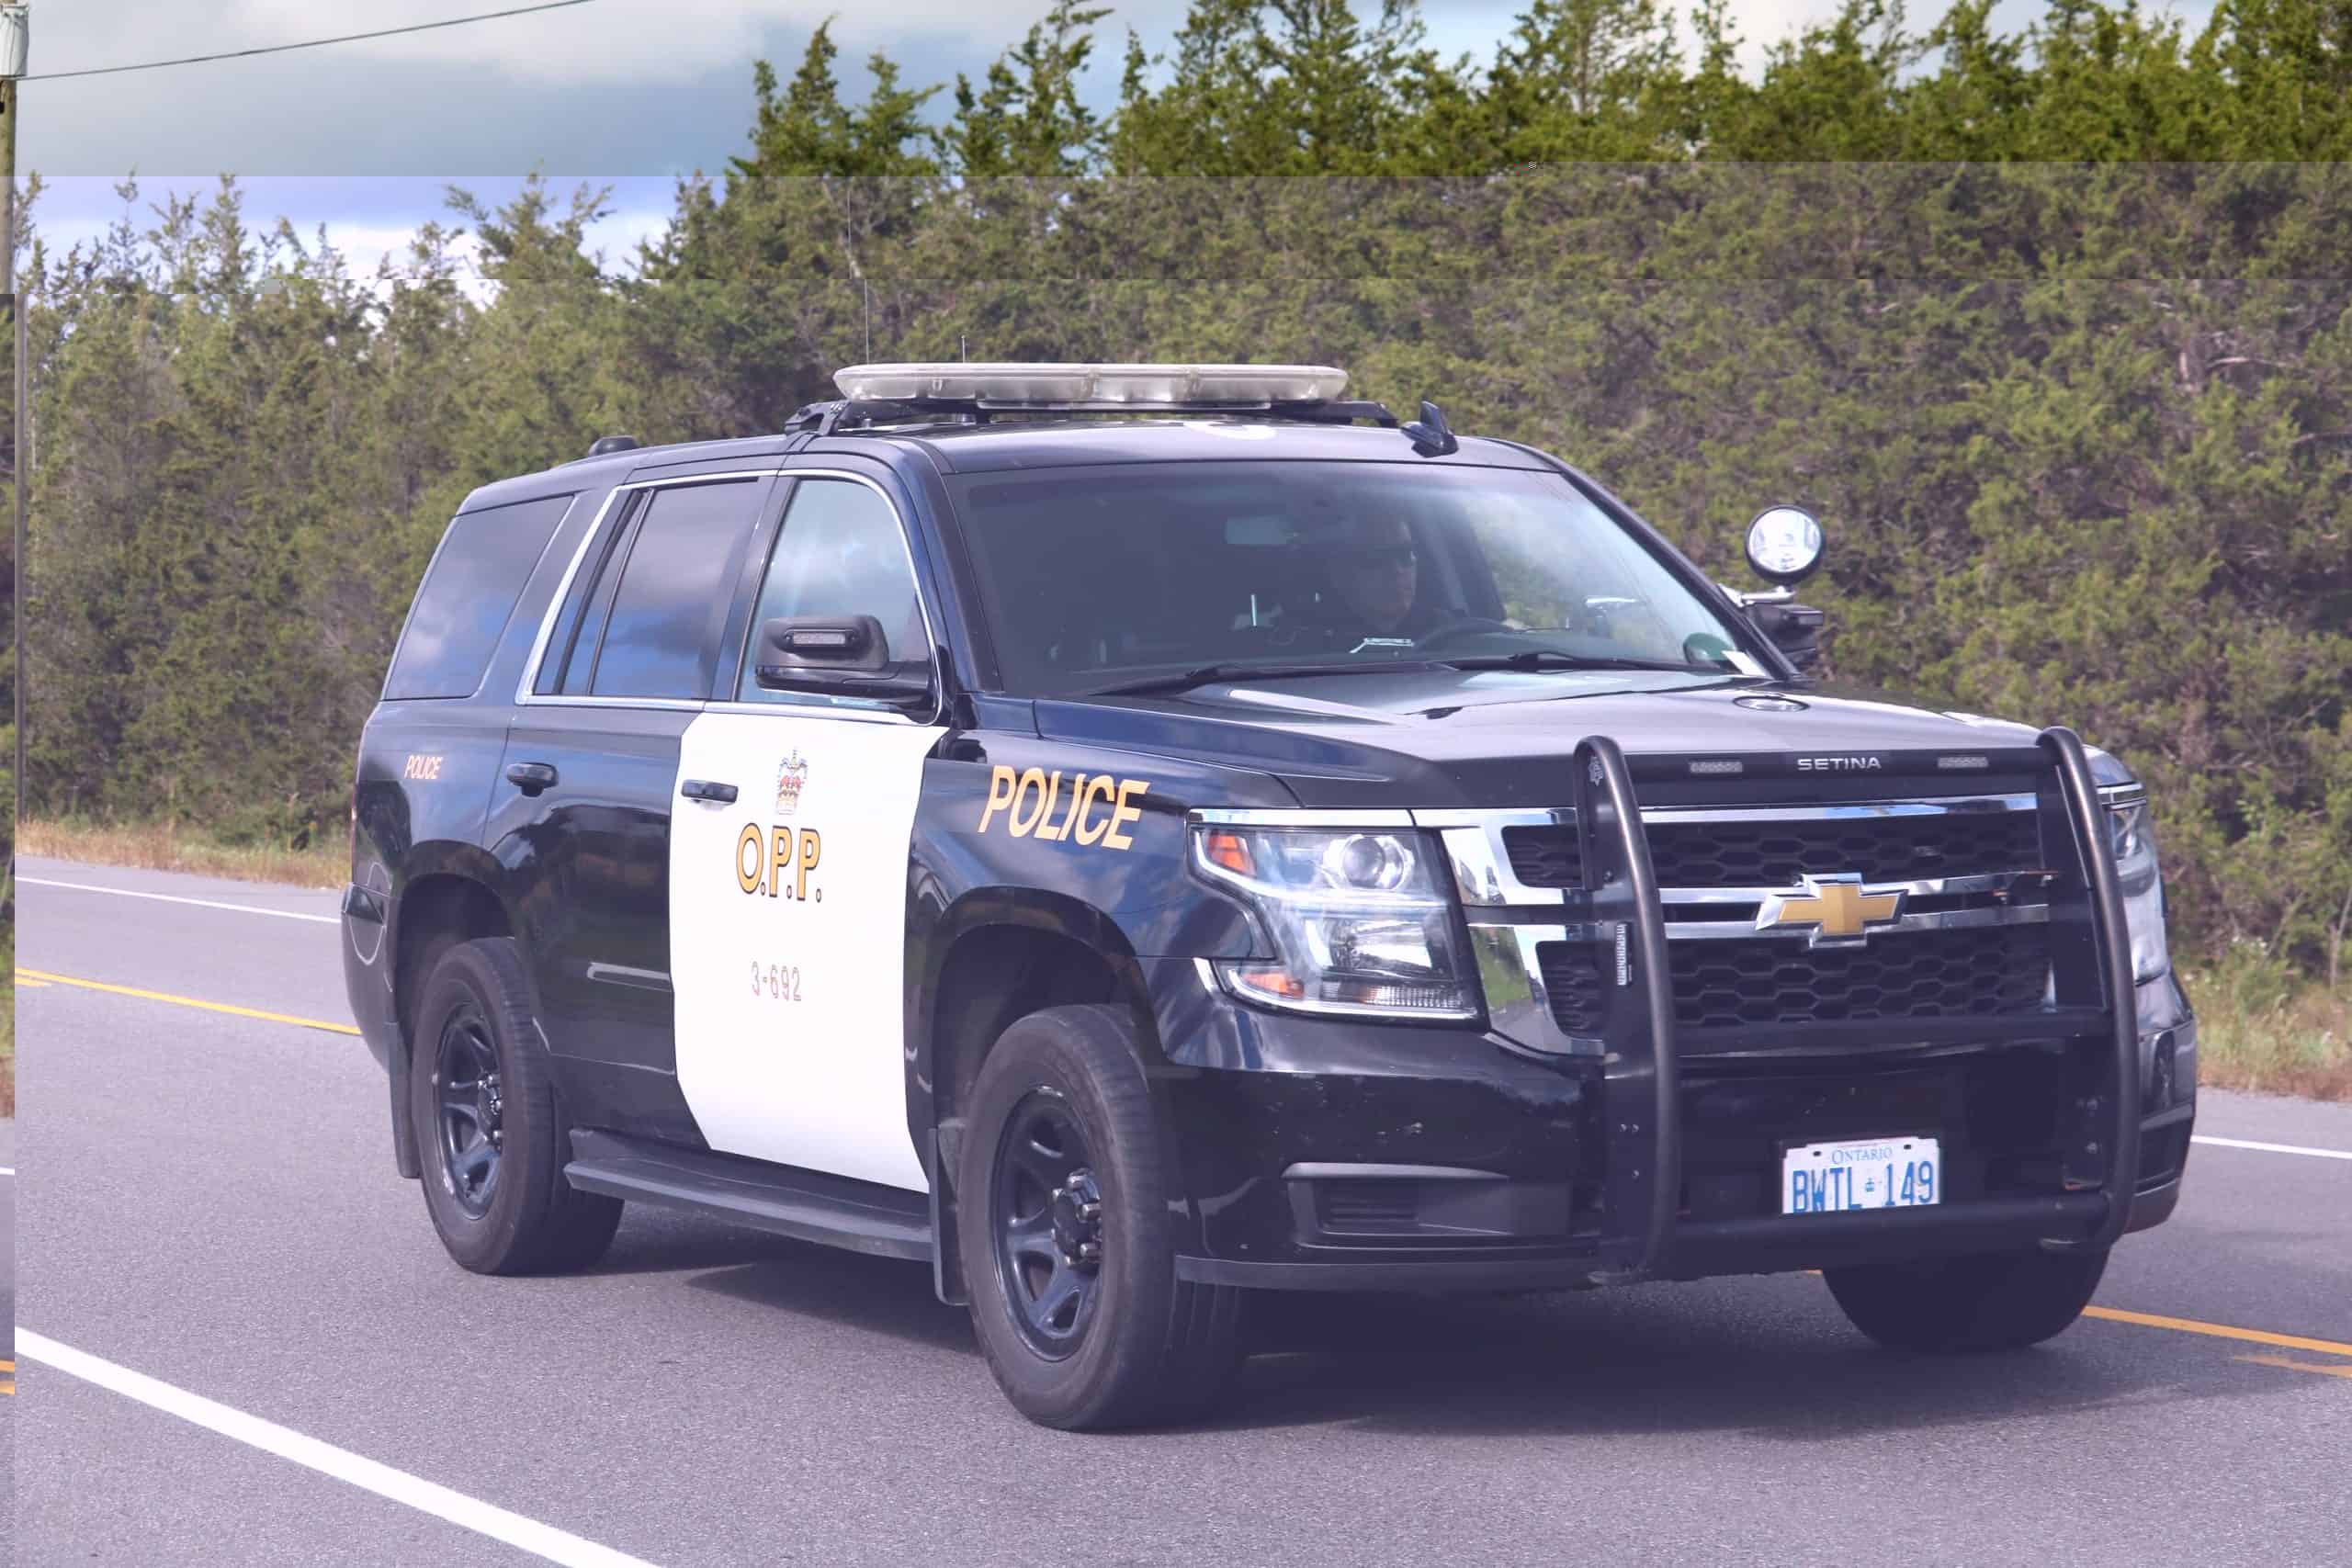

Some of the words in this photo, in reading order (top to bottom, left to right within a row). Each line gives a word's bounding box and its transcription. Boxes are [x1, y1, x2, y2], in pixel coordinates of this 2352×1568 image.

[404, 754, 443, 779] POLICE
[1797, 757, 1882, 771] SETINA
[978, 764, 1150, 851] POLICE
[736, 822, 822, 904] O.P.P.
[751, 961, 802, 1001] 3-692
[1831, 1146, 1893, 1165] ONTARIO
[1885, 1160, 1933, 1206] 149
